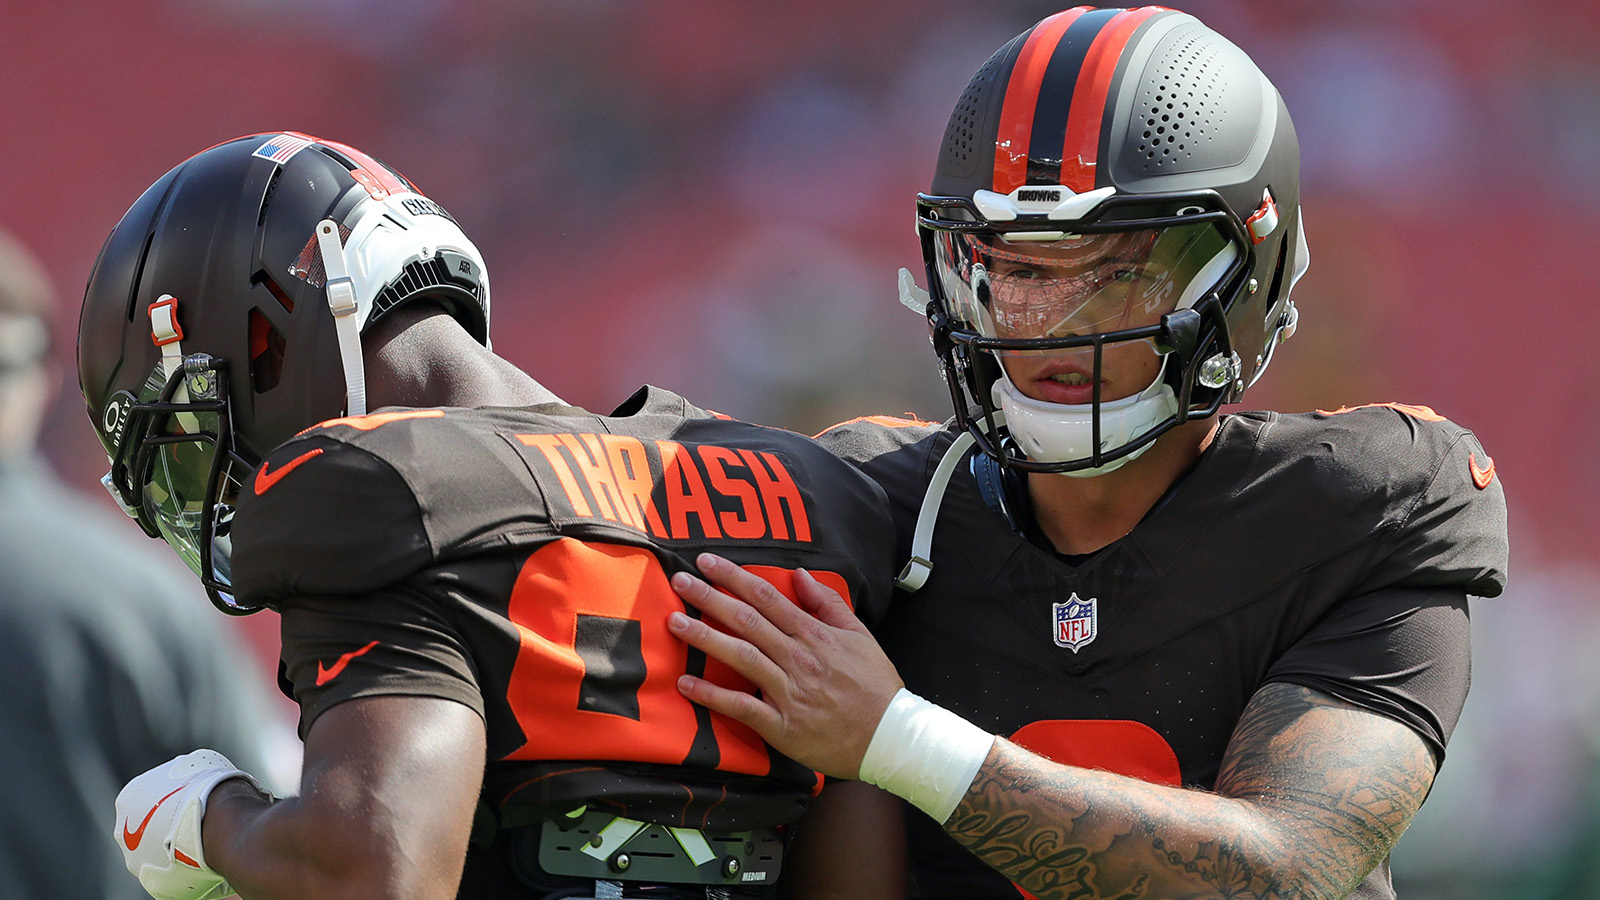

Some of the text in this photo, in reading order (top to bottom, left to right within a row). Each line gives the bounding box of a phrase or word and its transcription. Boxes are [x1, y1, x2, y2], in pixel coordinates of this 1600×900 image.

[1018, 190, 1061, 202] BROWNS
[113, 400, 131, 447] OAKLEY
[514, 433, 812, 542] THRASH
[1060, 619, 1089, 641] NFL
[742, 872, 766, 882] MEDIUM
